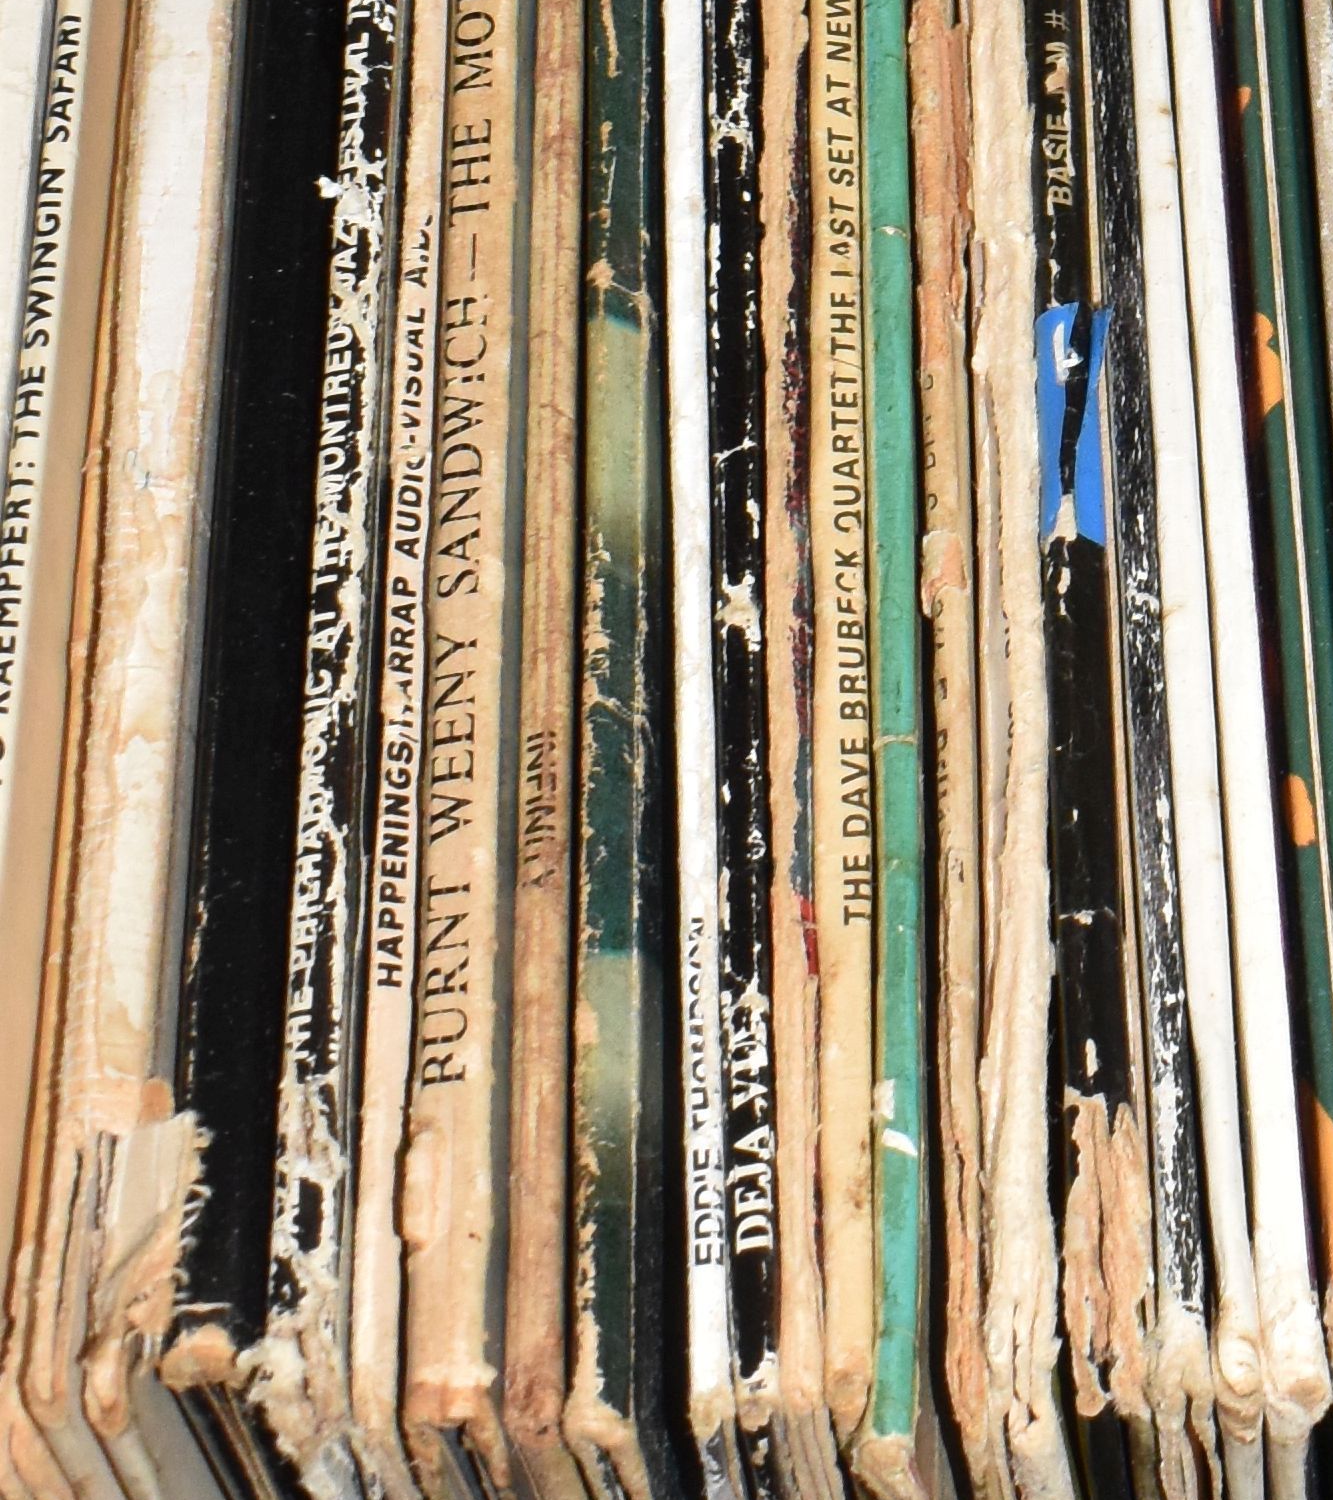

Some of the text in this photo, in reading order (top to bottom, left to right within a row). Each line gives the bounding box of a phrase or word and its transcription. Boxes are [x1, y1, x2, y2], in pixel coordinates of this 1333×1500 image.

[827, 72, 856, 115] AT
[828, 125, 857, 188] SET
[449, 117, 494, 228] THE
[14, 160, 68, 438] THE SWINGIN'
[436, 294, 489, 596] SANDWICH
[836, 546, 869, 720] BRUBECK
[428, 632, 481, 840] WEENY
[840, 735, 871, 837] DAVE
[842, 849, 873, 924] THE
[419, 871, 474, 1085] BURNT
